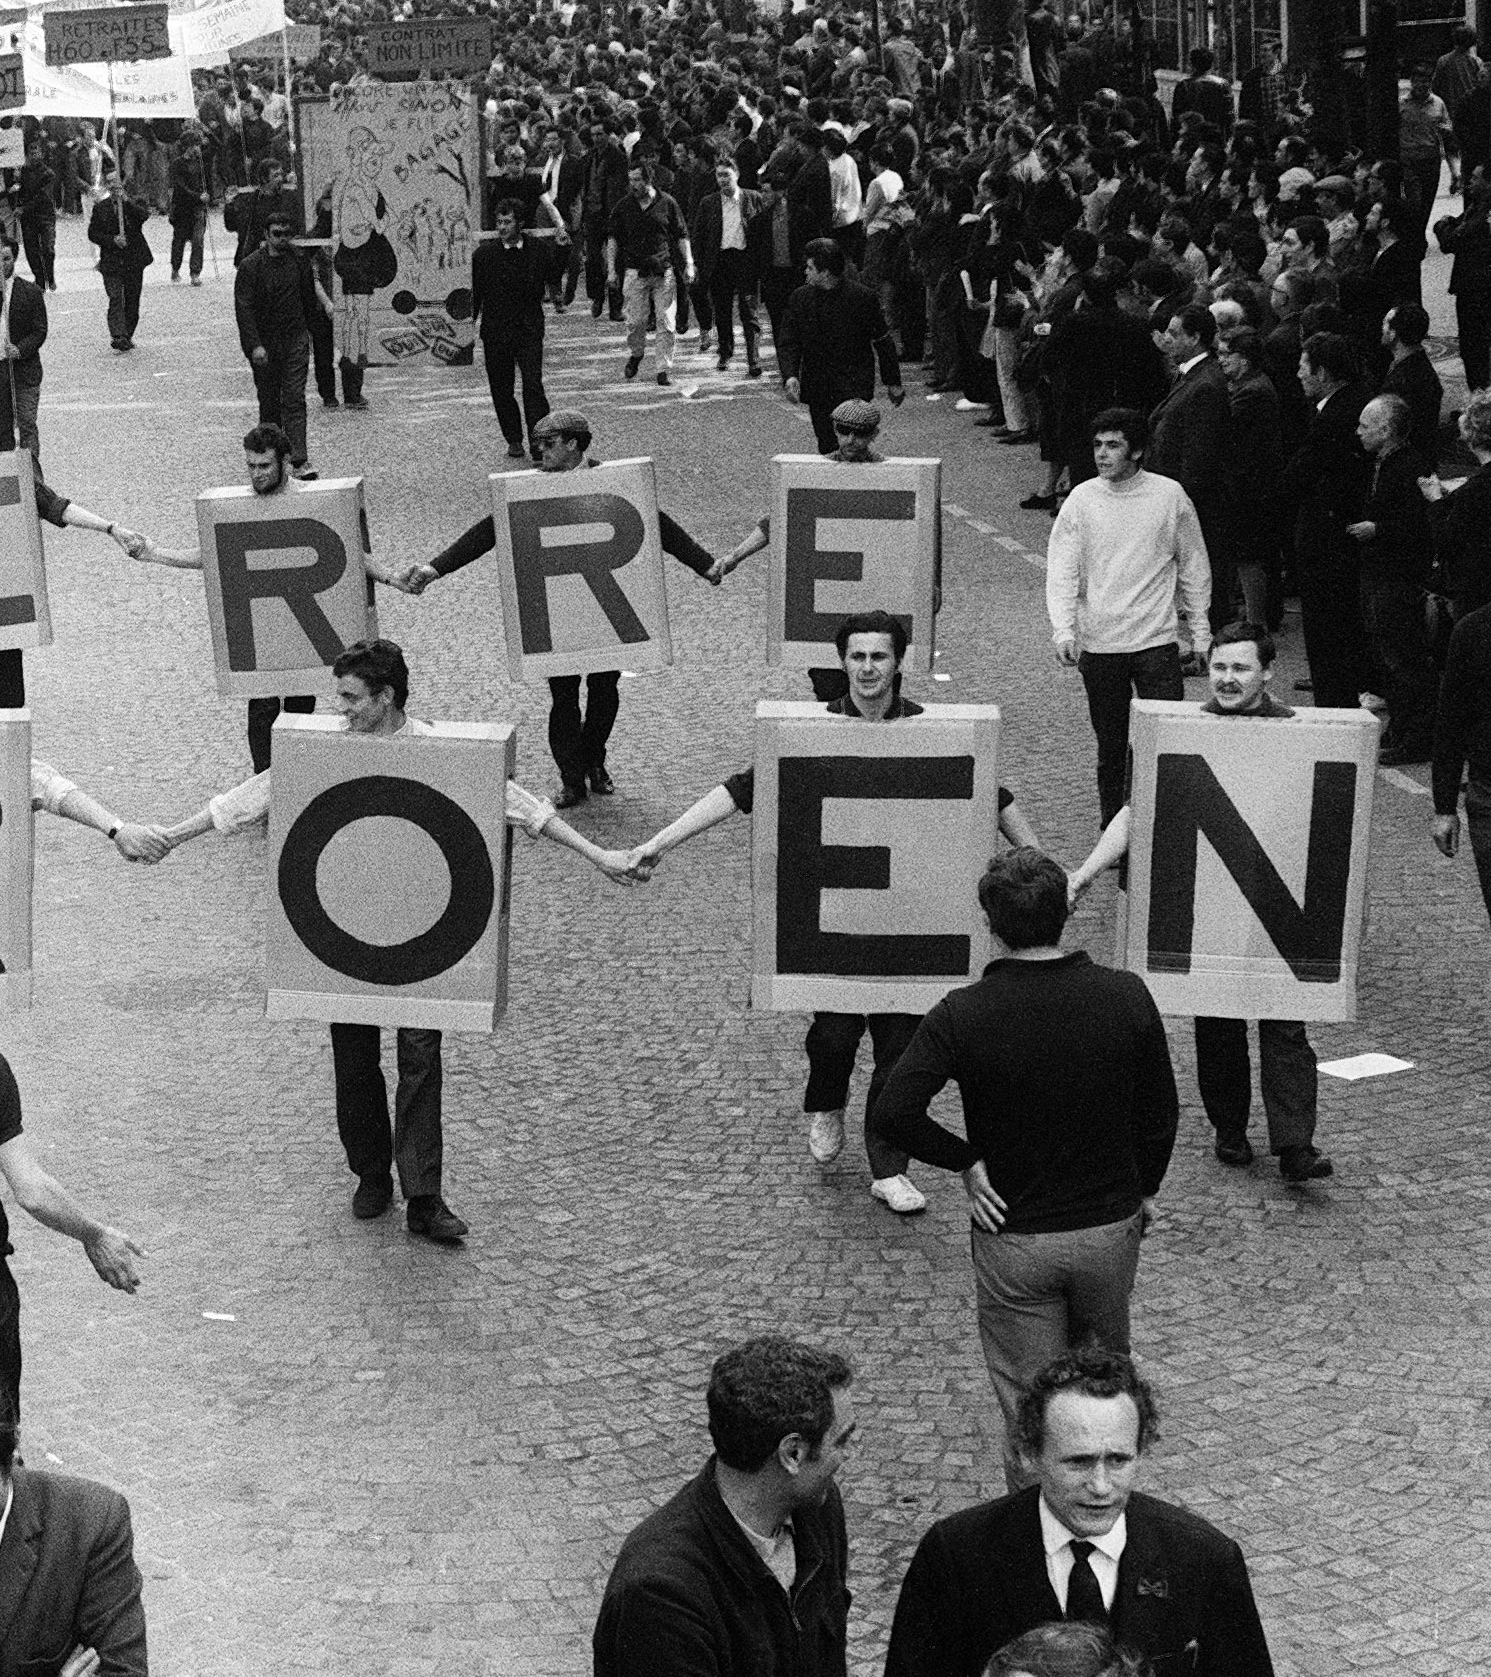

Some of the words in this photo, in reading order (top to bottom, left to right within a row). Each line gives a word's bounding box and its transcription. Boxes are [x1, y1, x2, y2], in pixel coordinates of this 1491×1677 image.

[60, 17, 165, 38] RETRAITES
[381, 28, 457, 42] CONTRAT
[377, 46, 411, 62] NON
[420, 39, 485, 61] LIMITE
[214, 518, 348, 672] R
[510, 493, 648, 653] R
[785, 488, 916, 644] E
[278, 776, 494, 986] O
[776, 756, 974, 969] E
[1148, 754, 1356, 981] N
